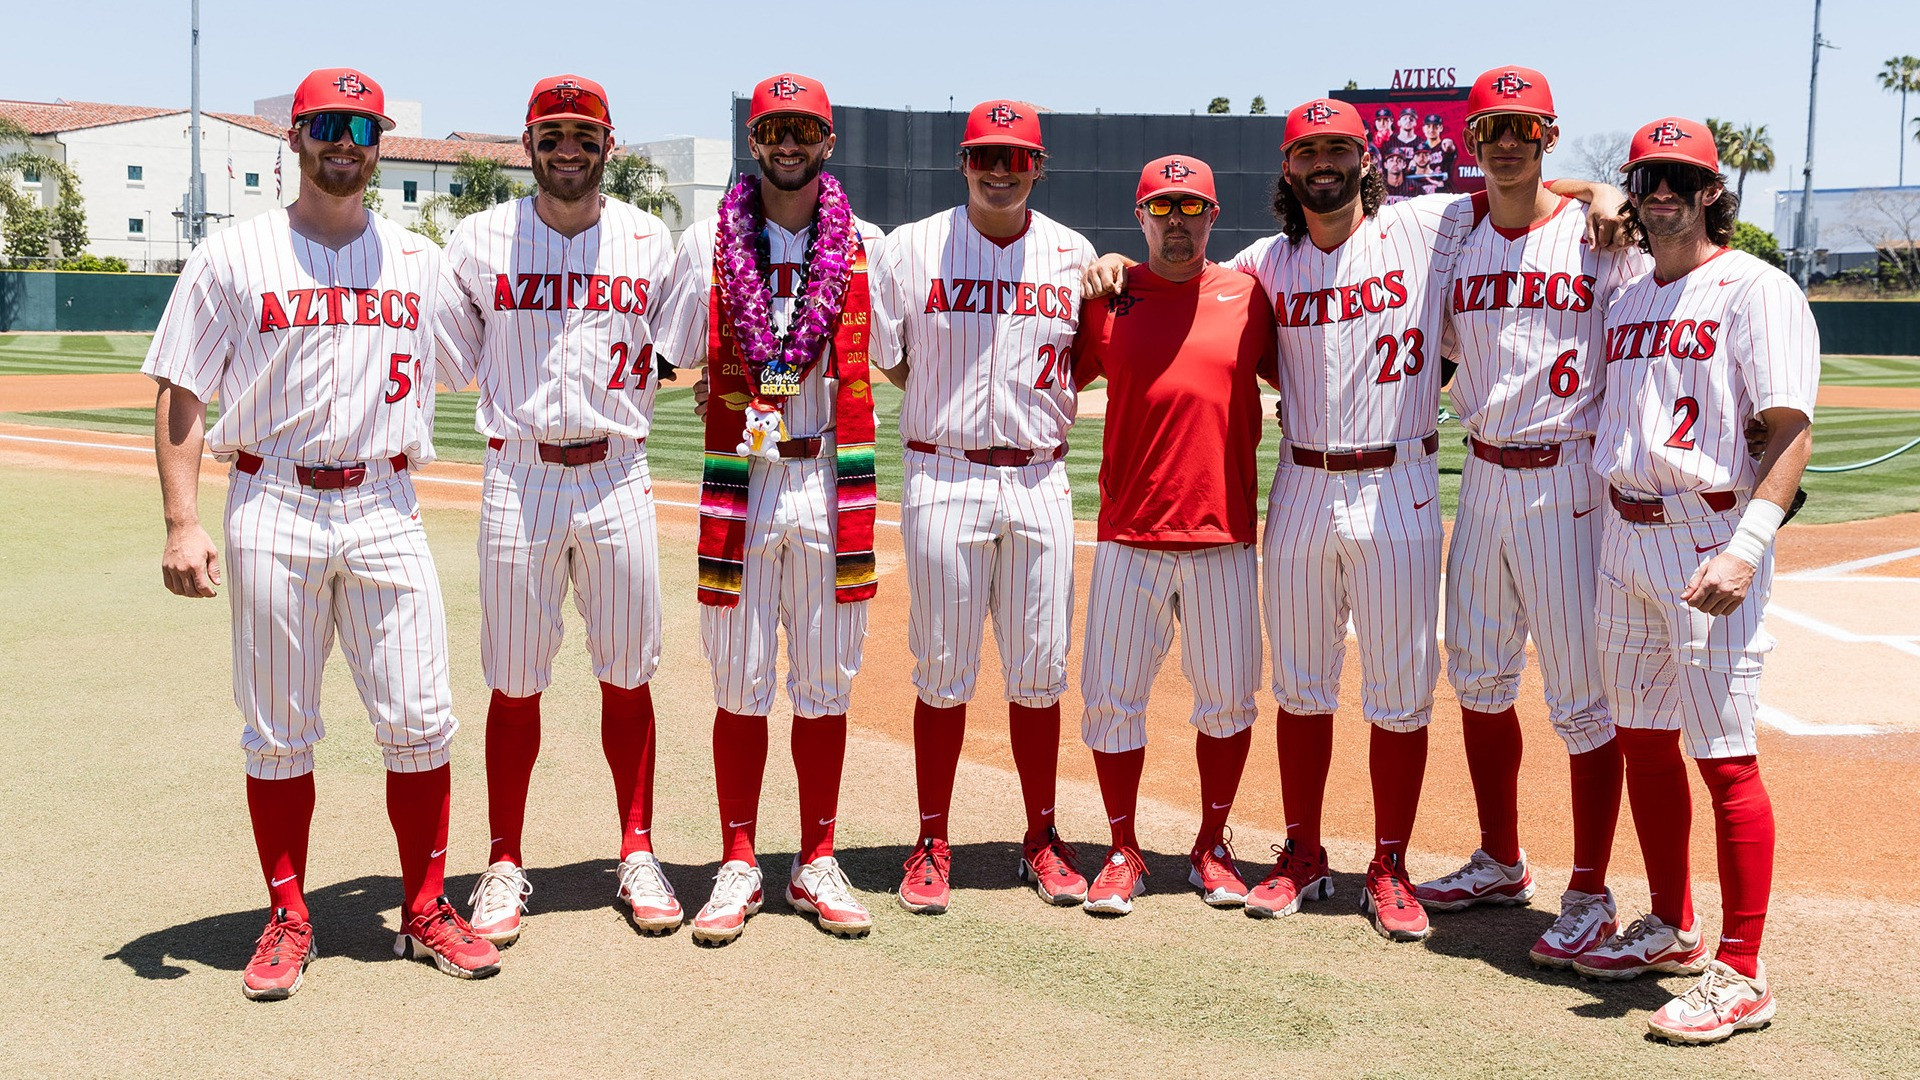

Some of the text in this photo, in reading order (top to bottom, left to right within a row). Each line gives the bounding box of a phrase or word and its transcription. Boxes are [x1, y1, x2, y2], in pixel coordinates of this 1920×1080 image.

[1390, 67, 1456, 89] AZTECS
[259, 286, 421, 333] AZTECS
[493, 272, 651, 316] AZTECS
[924, 278, 1072, 321] AZTECS
[1275, 269, 1408, 327] AZTECS
[1453, 270, 1597, 316] AZTECS
[842, 311, 867, 325] CLASS
[852, 332, 862, 344] OF
[607, 341, 654, 390] 24
[847, 351, 867, 364] 2024
[1034, 343, 1071, 390] 20
[1376, 328, 1424, 384] 23
[1549, 349, 1580, 398] 6
[760, 384, 801, 396] GRAD!
[1664, 396, 1700, 450] 2
